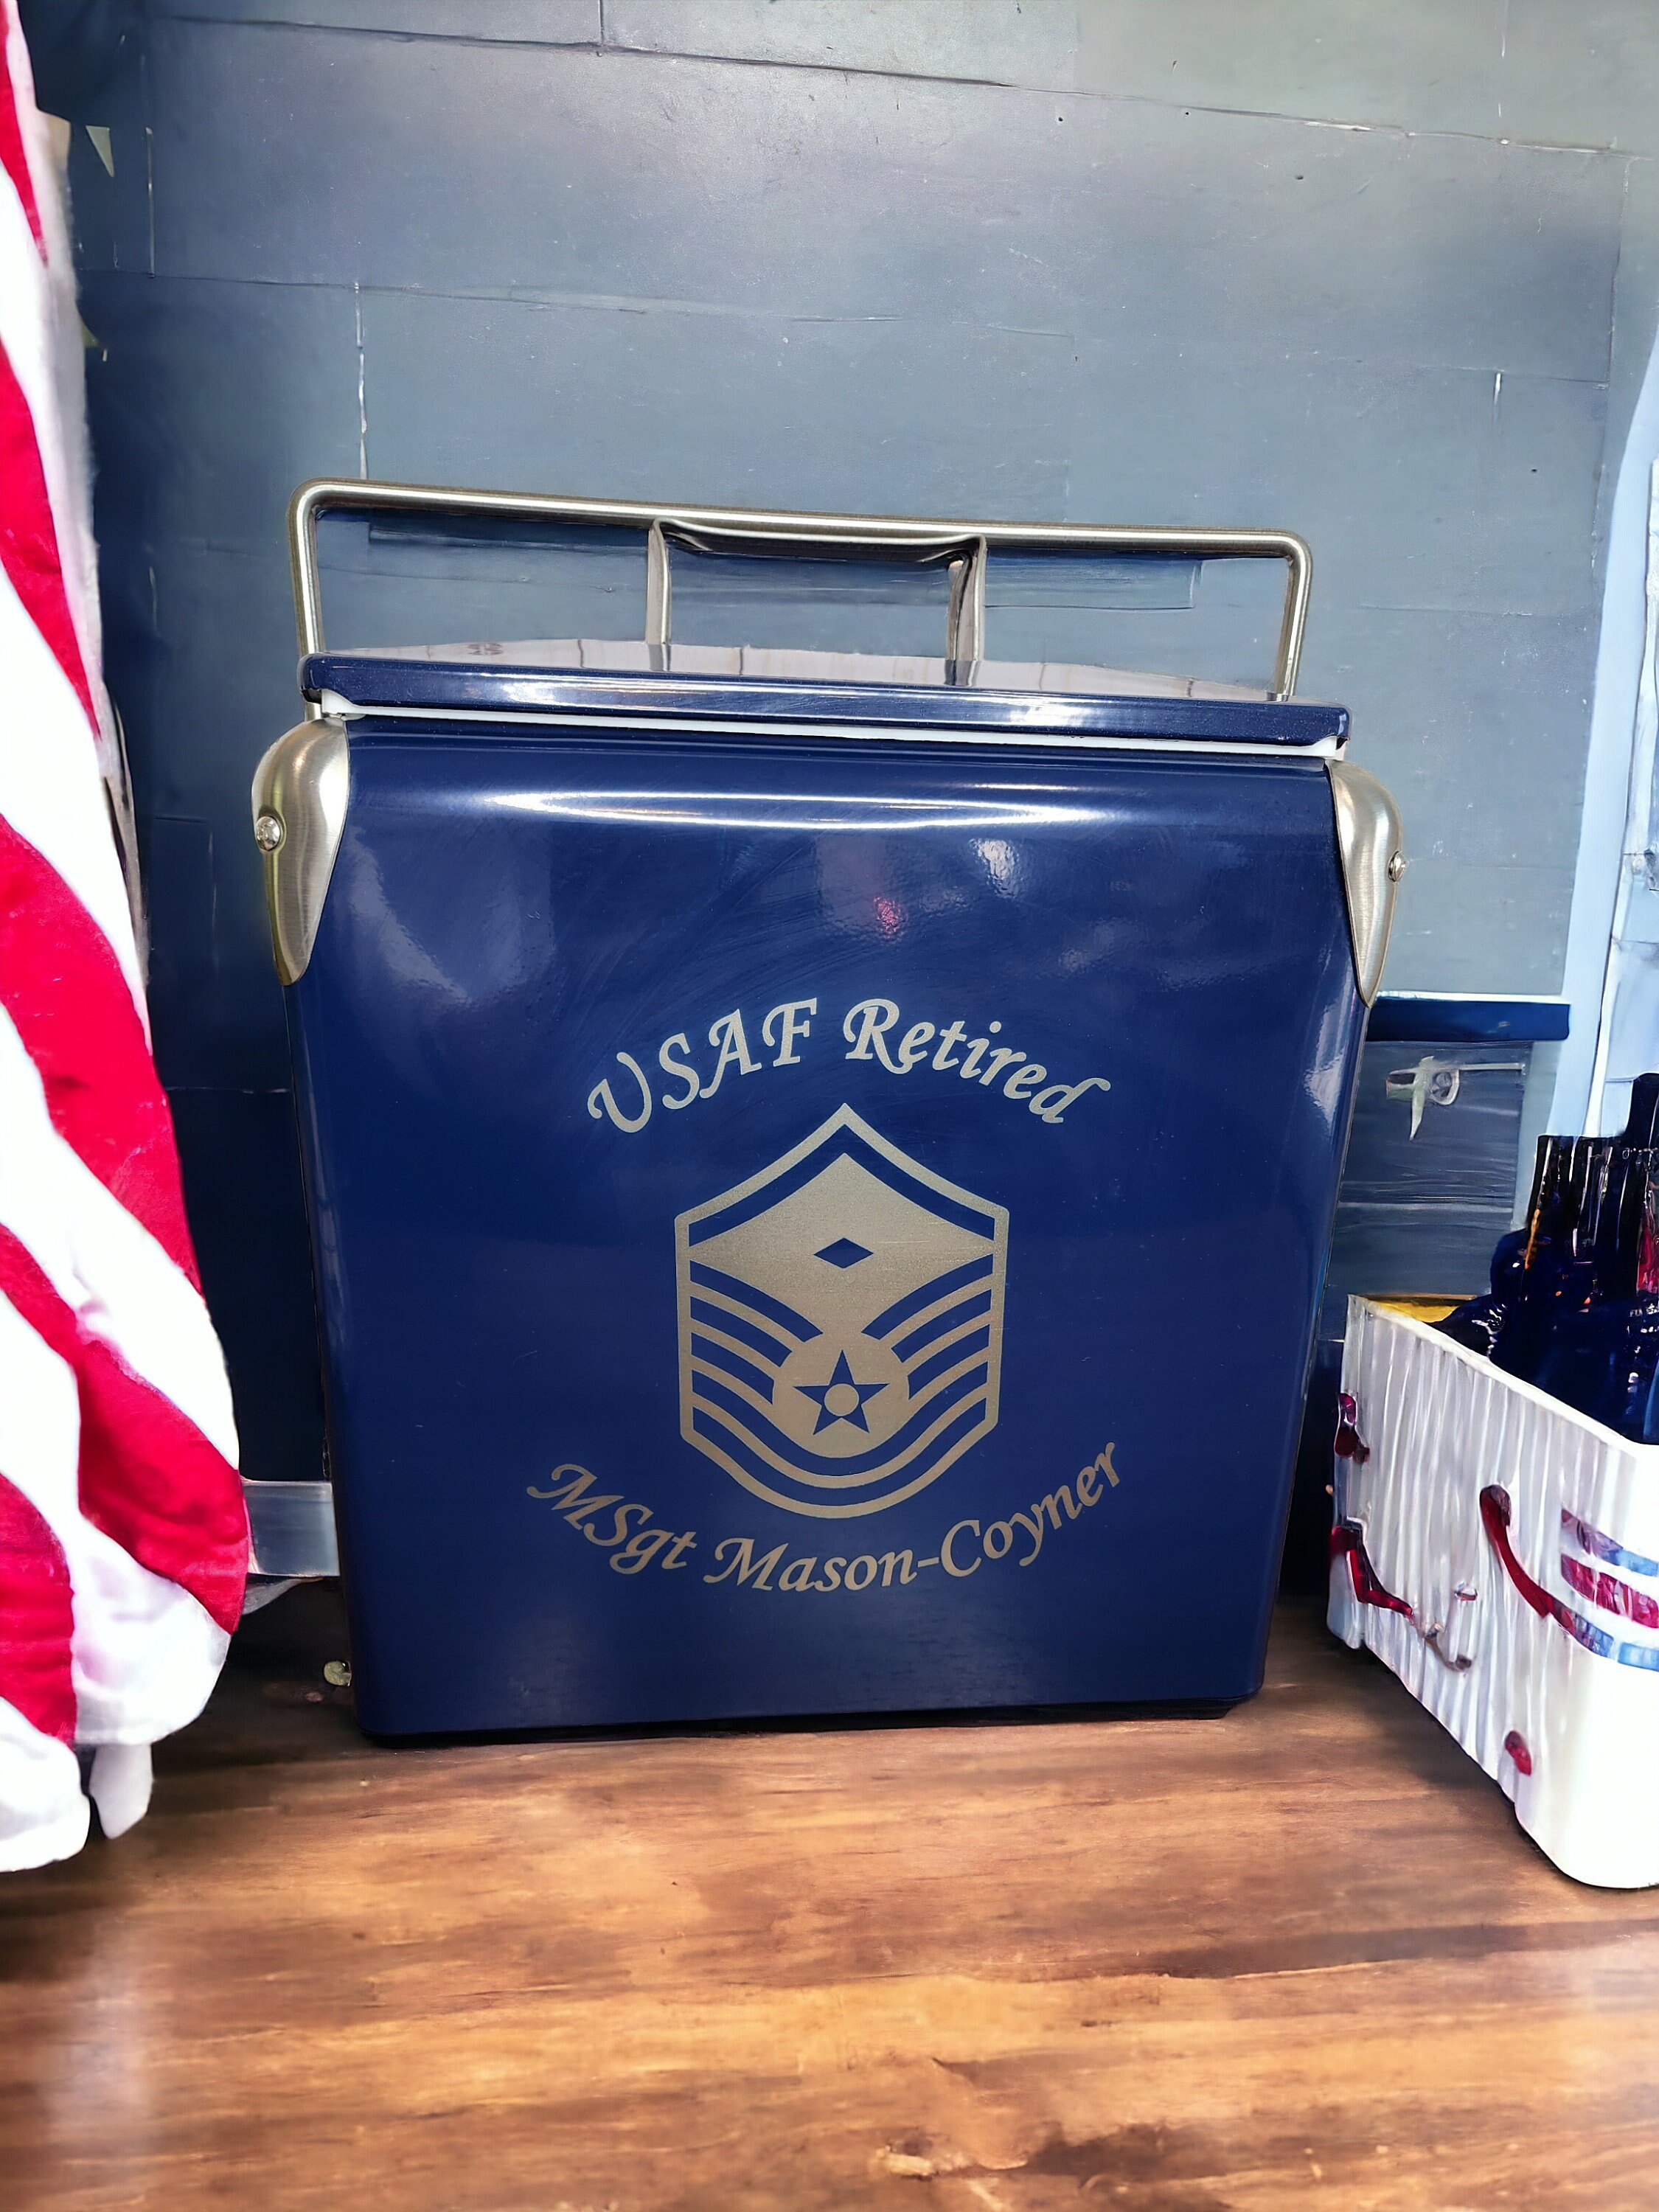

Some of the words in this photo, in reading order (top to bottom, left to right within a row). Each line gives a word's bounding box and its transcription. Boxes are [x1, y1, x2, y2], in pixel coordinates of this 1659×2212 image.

[588, 998, 818, 1133] USAF
[843, 998, 1111, 1124] Retired
[526, 1464, 698, 1574] MSgt
[703, 1441, 1120, 1592] Mason-Coyner
